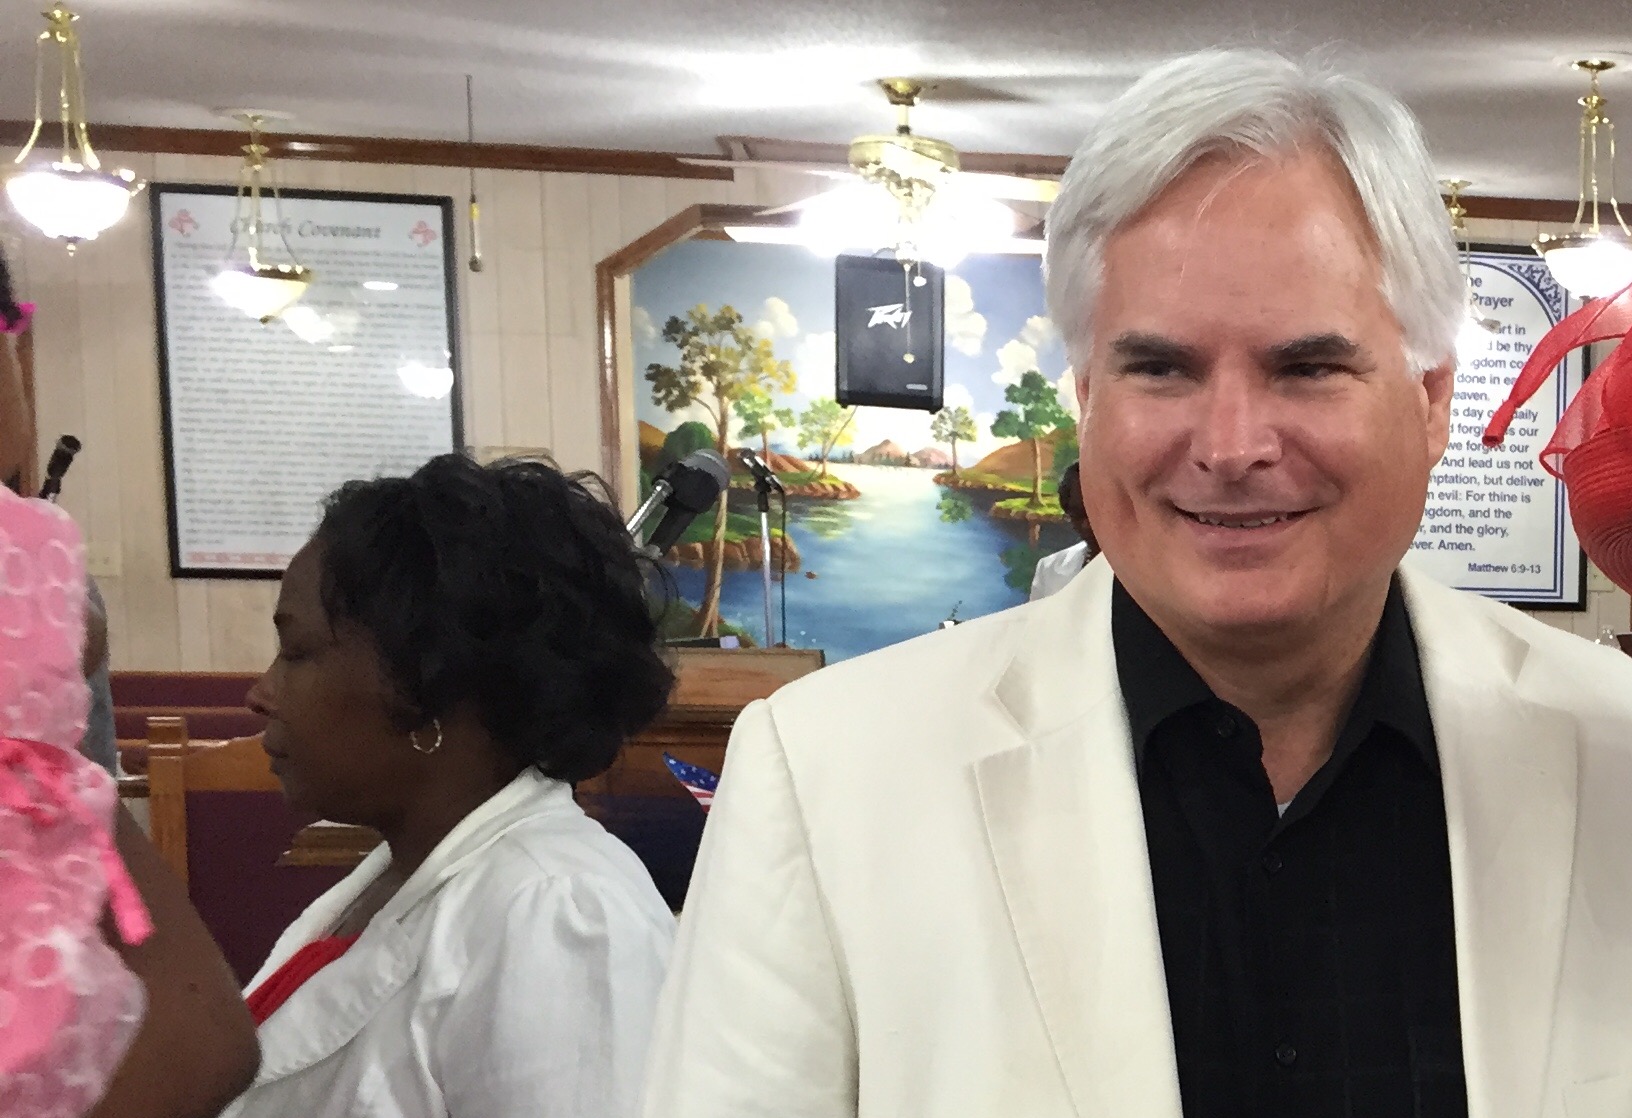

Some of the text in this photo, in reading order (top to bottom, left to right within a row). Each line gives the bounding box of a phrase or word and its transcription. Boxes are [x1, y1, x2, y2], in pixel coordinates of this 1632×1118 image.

[299, 220, 381, 239] Covenant
[1470, 292, 1514, 310] Prayer
[1514, 324, 1526, 335] in
[1496, 340, 1511, 352] be
[1514, 342, 1533, 356] thy
[1471, 357, 1525, 370] gdom co
[1457, 373, 1486, 384] done
[1489, 373, 1500, 385] in
[1454, 391, 1490, 402] eaven.
[1463, 407, 1484, 421] day
[1458, 423, 1485, 438] forgi
[1518, 427, 1539, 437] our
[1509, 443, 1529, 453] our
[1441, 456, 1533, 470] And lead us not
[1429, 473, 1545, 487] ptation, but deliver
[1465, 490, 1485, 501] For
[1488, 491, 1518, 503] thine
[1521, 492, 1531, 503] is
[1424, 506, 1513, 519] gdom, and the
[1429, 523, 1452, 534] and
[1455, 523, 1474, 535] the
[1477, 524, 1509, 538] glory,
[1437, 539, 1476, 551] Amen.
[1468, 563, 1541, 574] Matthew 6:9-13
